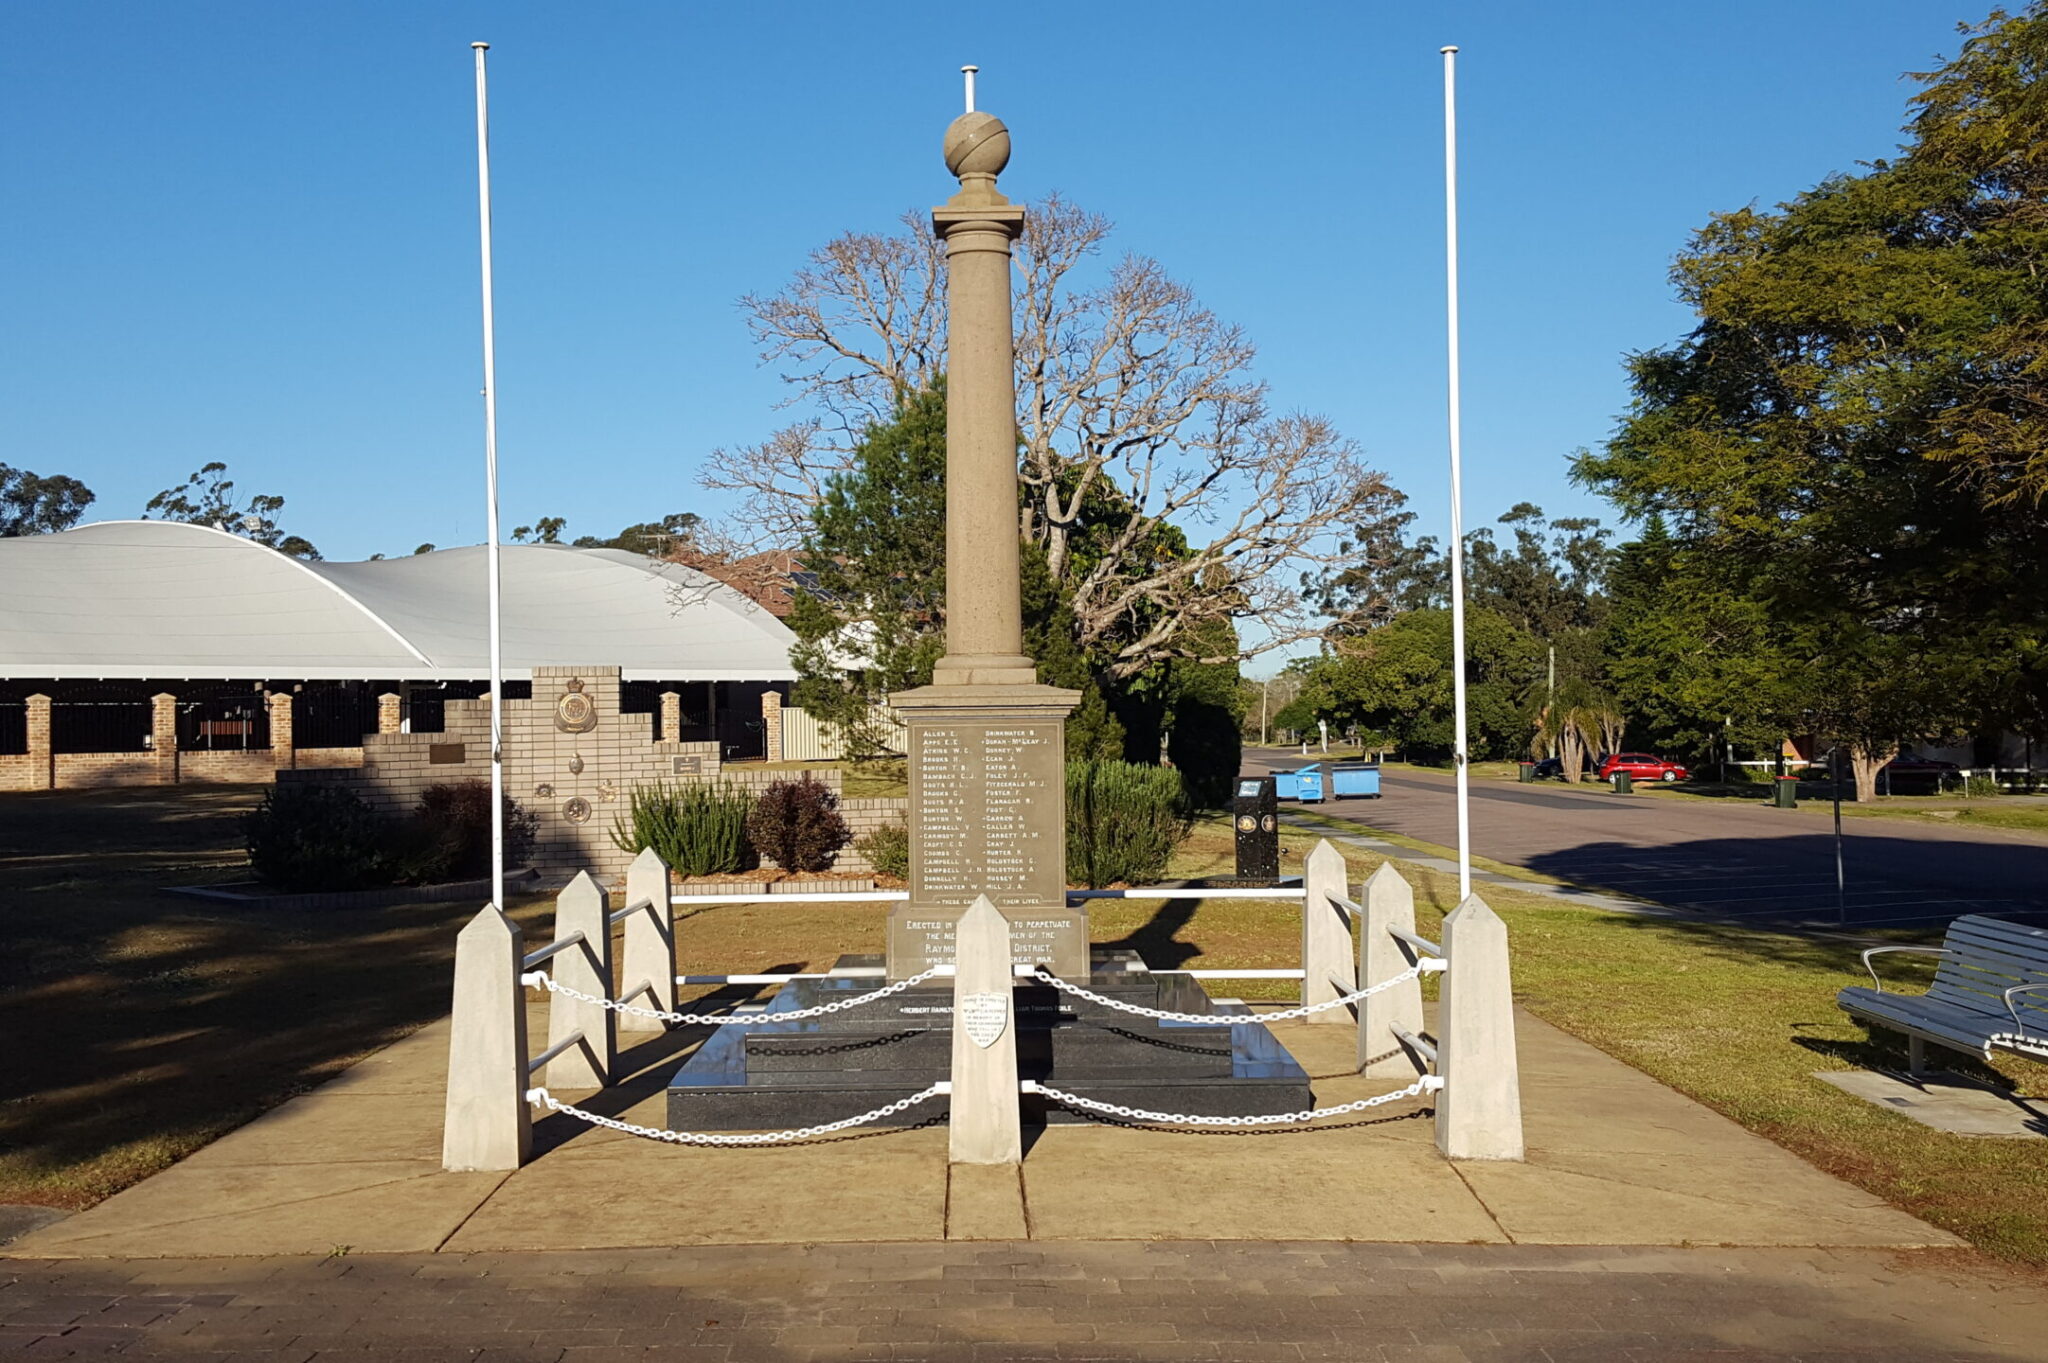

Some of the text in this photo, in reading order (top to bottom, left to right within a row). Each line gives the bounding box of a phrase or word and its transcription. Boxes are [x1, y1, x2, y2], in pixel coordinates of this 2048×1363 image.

[923, 747, 948, 755] ATKINS
[923, 858, 960, 866] CAMPBELL
[906, 920, 941, 929] ERECTED
[1014, 920, 1023, 928] TO
[1026, 920, 1071, 928] PERPETUATE
[926, 932, 940, 940] THE
[925, 944, 956, 953] RAYMO
